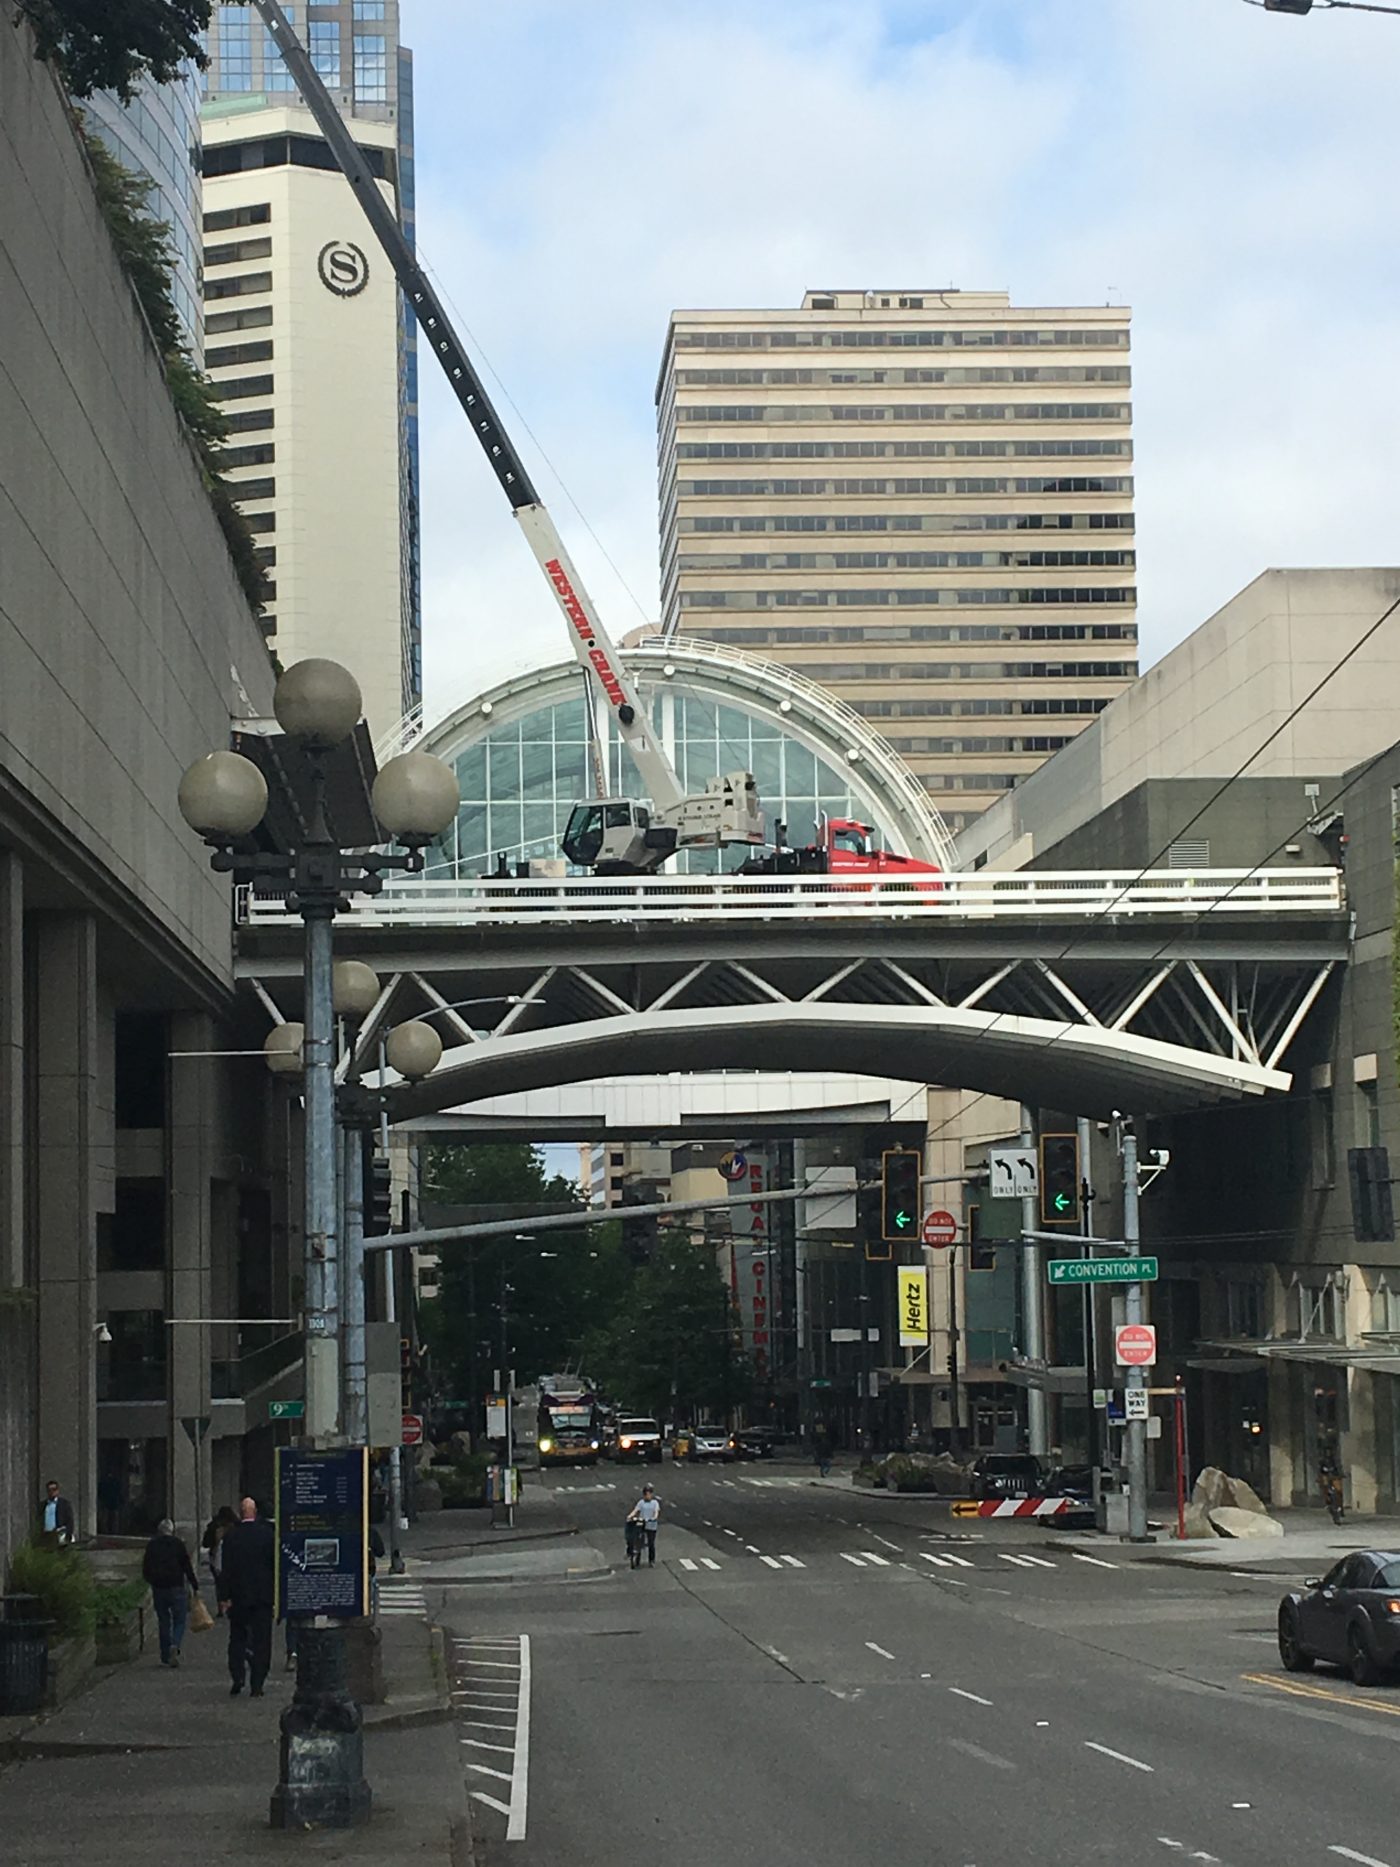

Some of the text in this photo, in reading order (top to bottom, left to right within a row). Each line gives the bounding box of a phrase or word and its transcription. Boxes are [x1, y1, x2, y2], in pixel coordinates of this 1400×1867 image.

[329, 250, 358, 283] S
[545, 558, 628, 706] WESTERN CRANE
[994, 1186, 1014, 1194] ONLY
[1017, 1185, 1038, 1194] ONLY
[749, 1164, 765, 1247] REGA
[1068, 1263, 1152, 1277] CONVENTION PL
[906, 1283, 921, 1331] Hertz
[1124, 1350, 1147, 1358] ENTER
[1128, 1391, 1145, 1399] ONE
[1128, 1400, 1146, 1408] WAY
